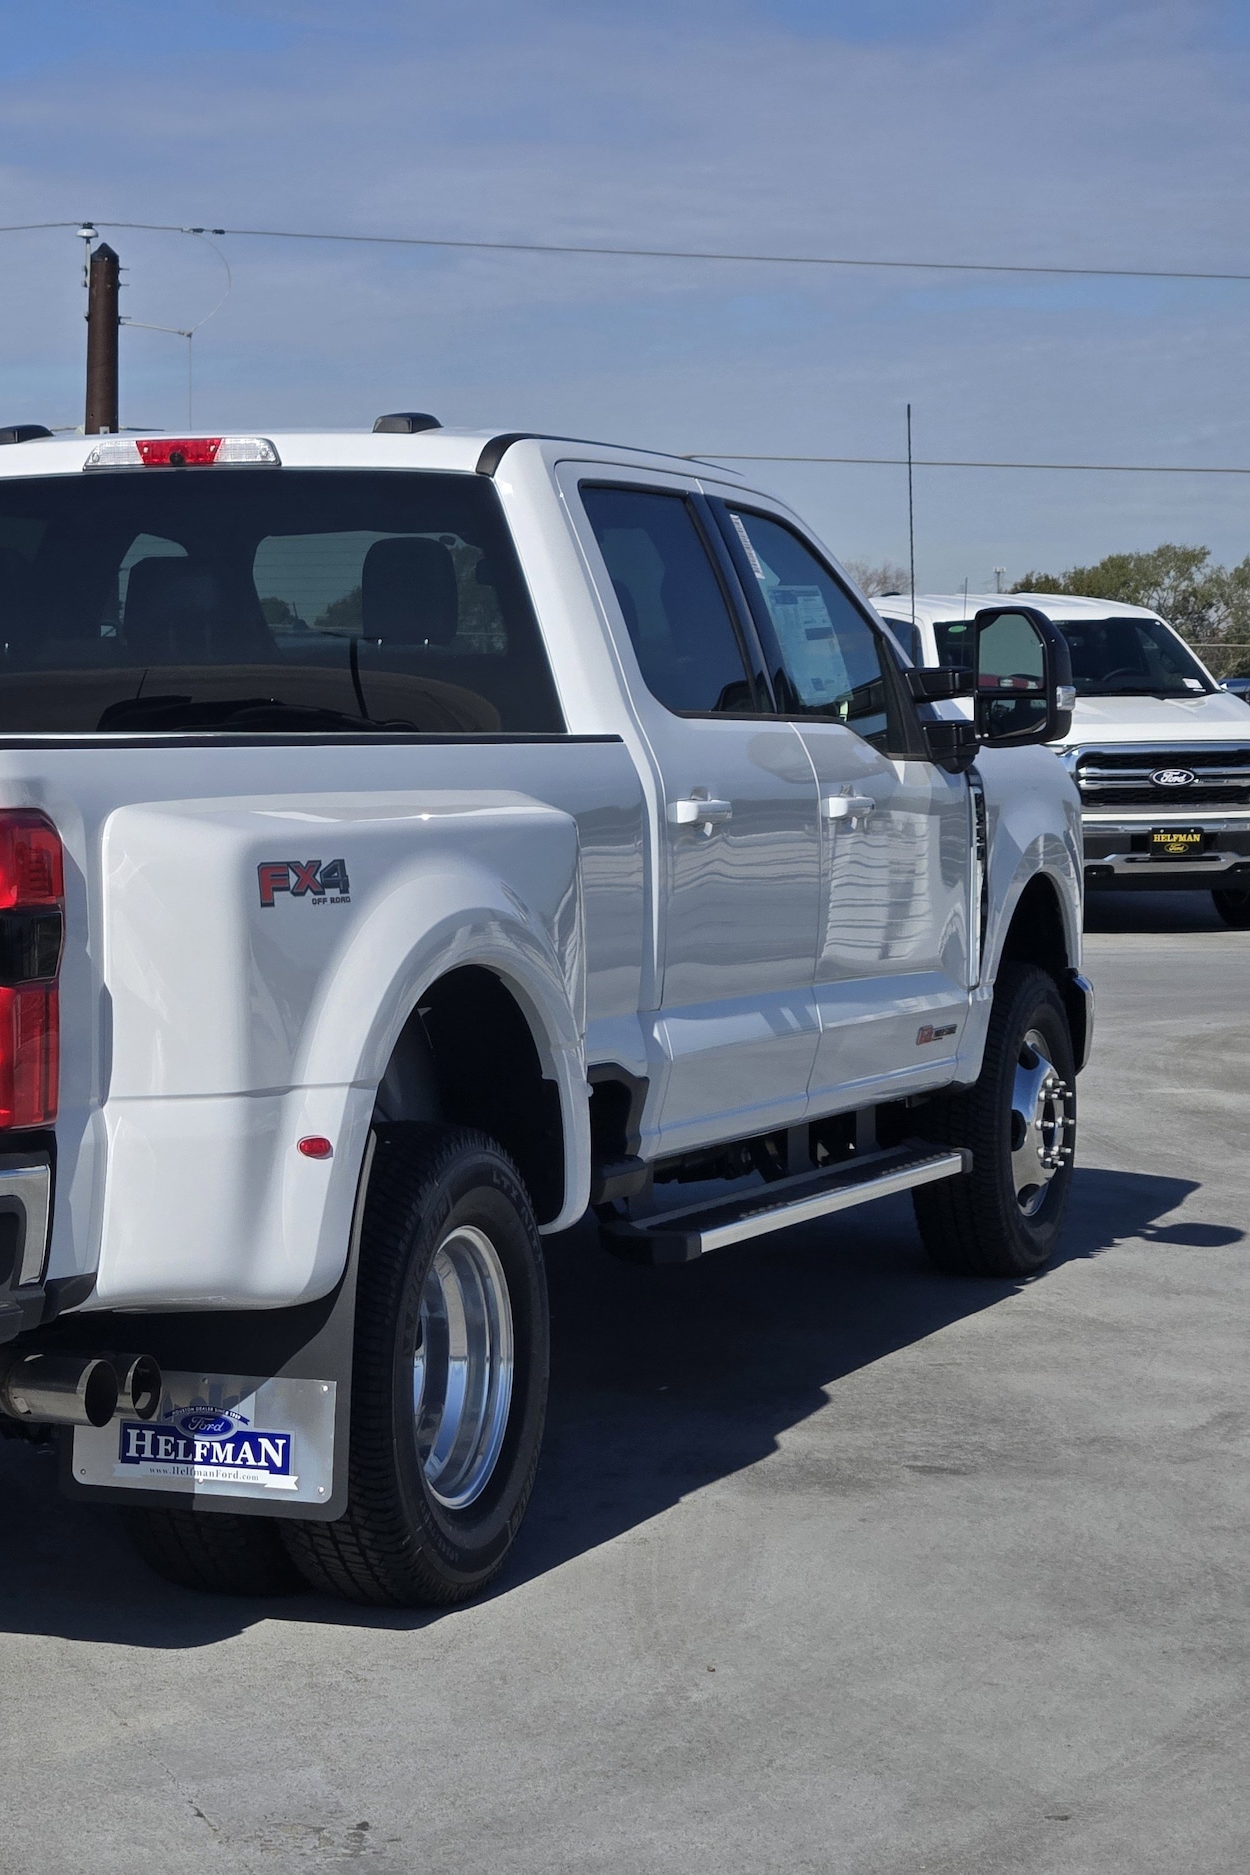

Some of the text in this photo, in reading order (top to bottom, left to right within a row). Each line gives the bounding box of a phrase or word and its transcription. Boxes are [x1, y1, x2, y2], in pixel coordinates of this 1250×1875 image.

[1152, 833, 1201, 843] HELFMAN
[1168, 843, 1184, 852] Ford
[257, 859, 350, 908] FX4
[311, 895, 351, 905] OFF ROAD
[188, 1416, 225, 1432] Ford
[125, 1428, 287, 1468] HELFMAN
[149, 1466, 260, 1482] www.HelfmanFord.com
